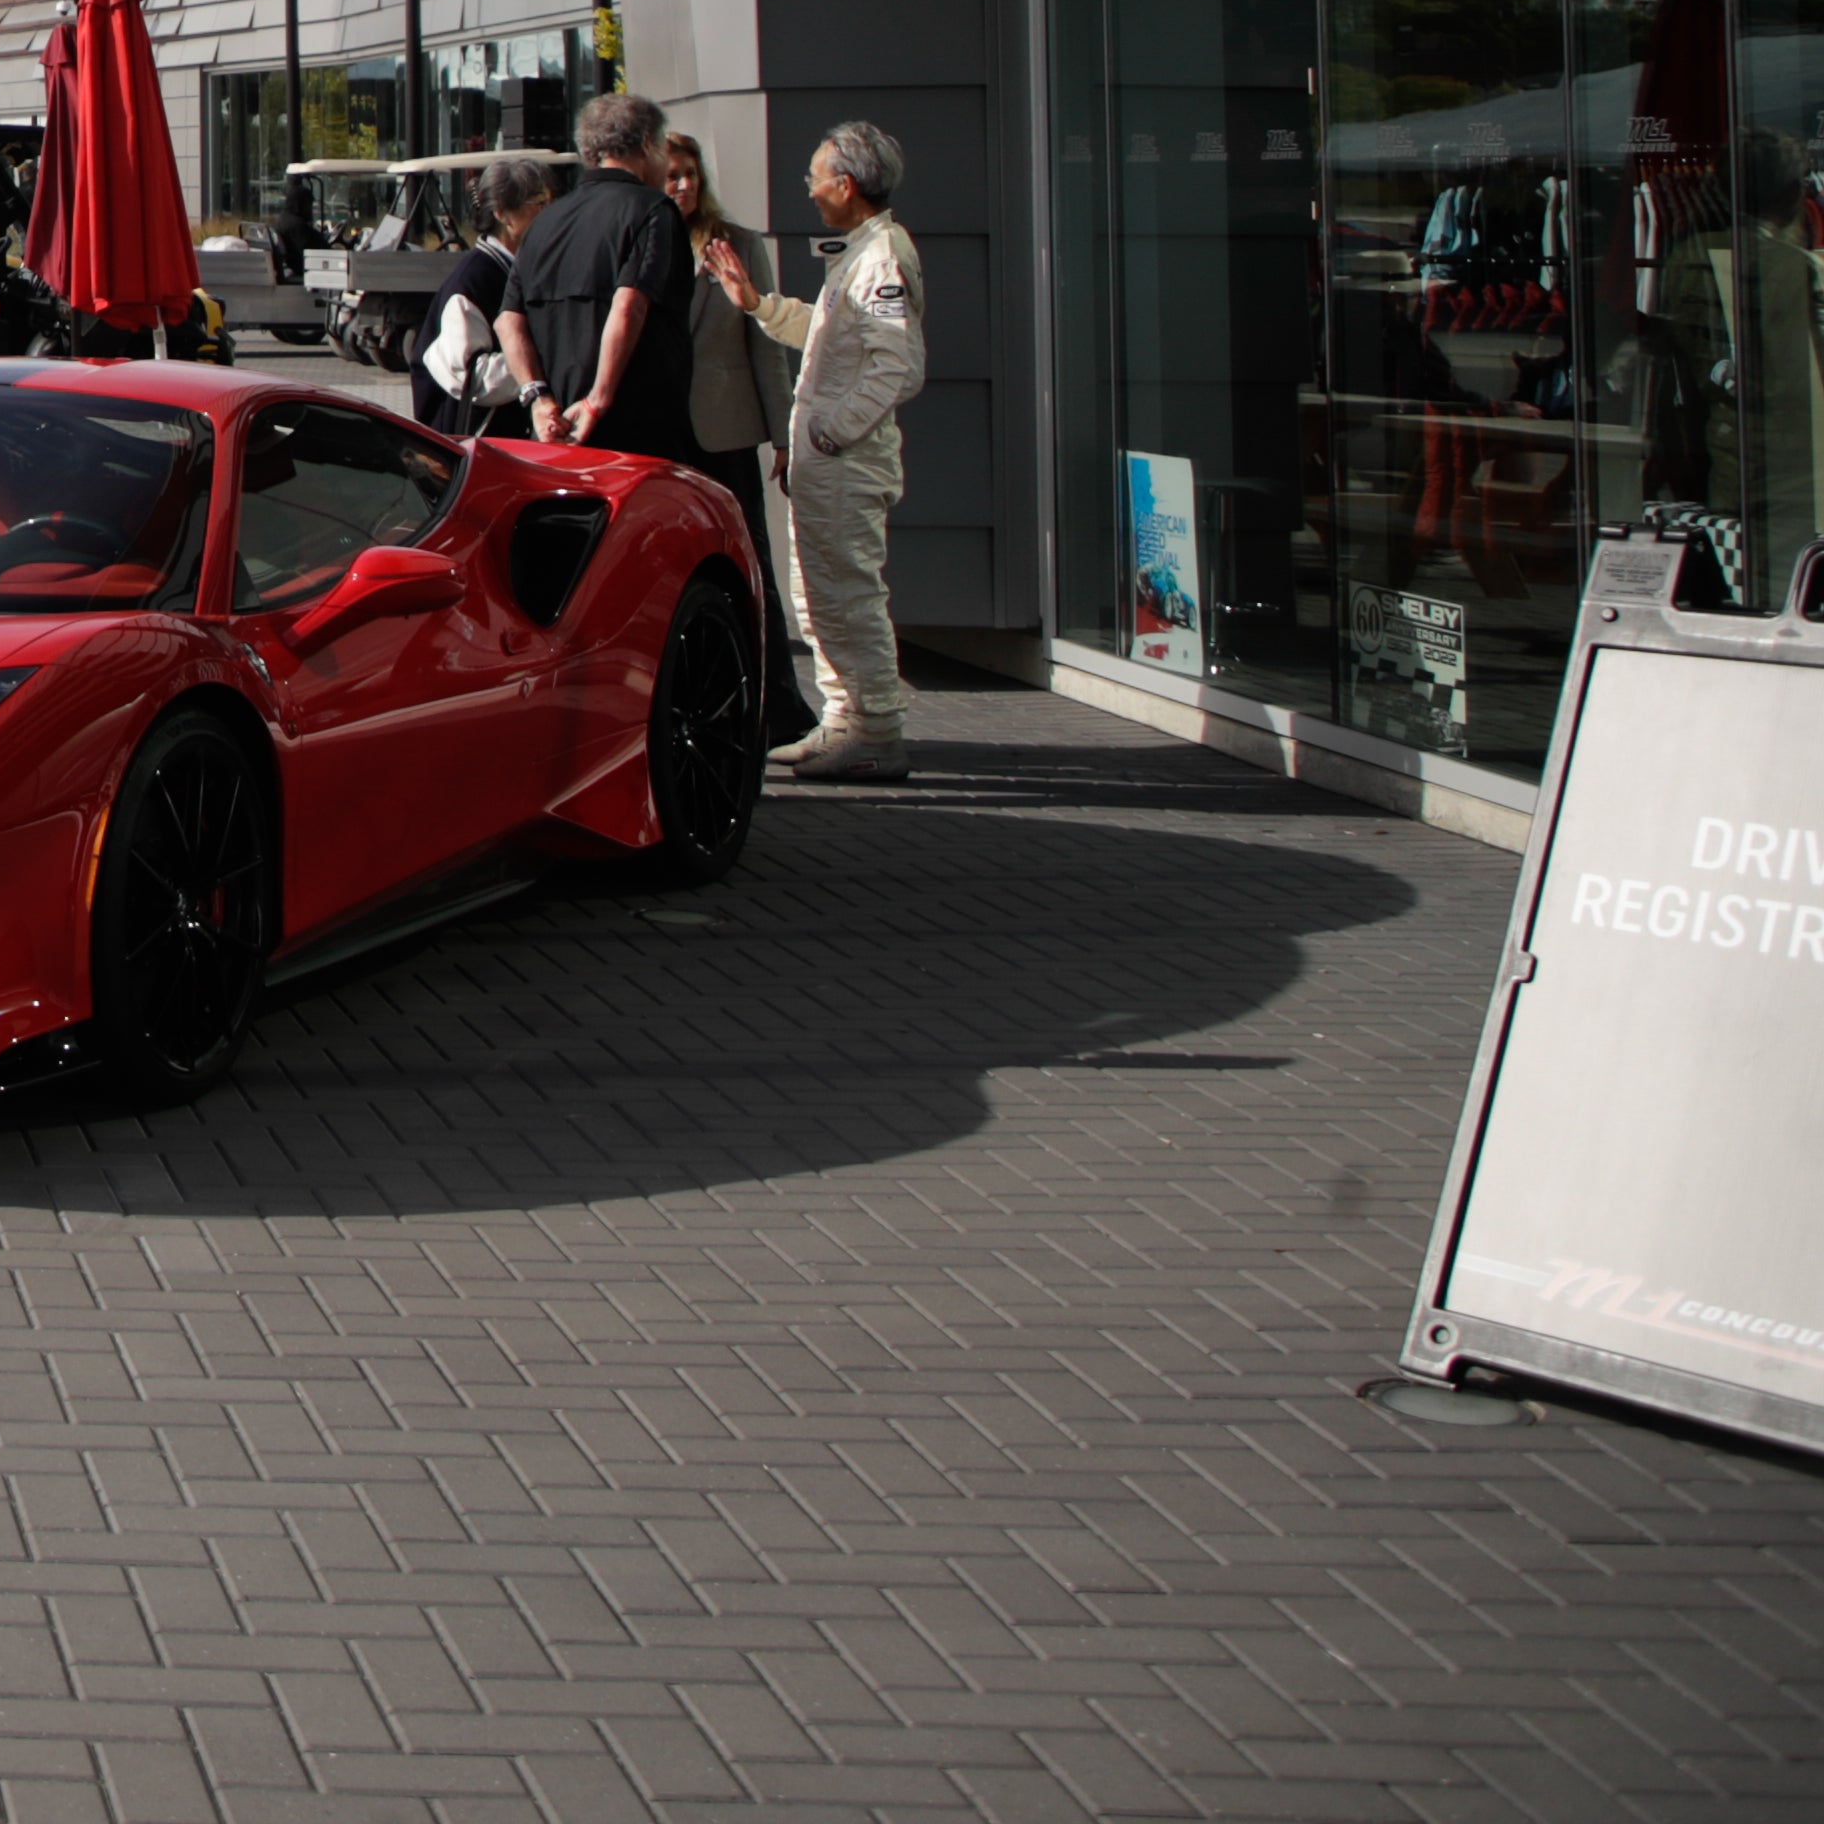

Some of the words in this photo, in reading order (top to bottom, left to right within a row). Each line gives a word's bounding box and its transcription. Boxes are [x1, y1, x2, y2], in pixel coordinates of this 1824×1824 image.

[1356, 601, 1380, 640] 60
[1381, 593, 1459, 629] SHELBY
[1423, 646, 1458, 667] 2022
[1690, 816, 1824, 886] DRIV
[1570, 872, 1824, 963] REGISTR
[1678, 1300, 1824, 1350] CONCOU
